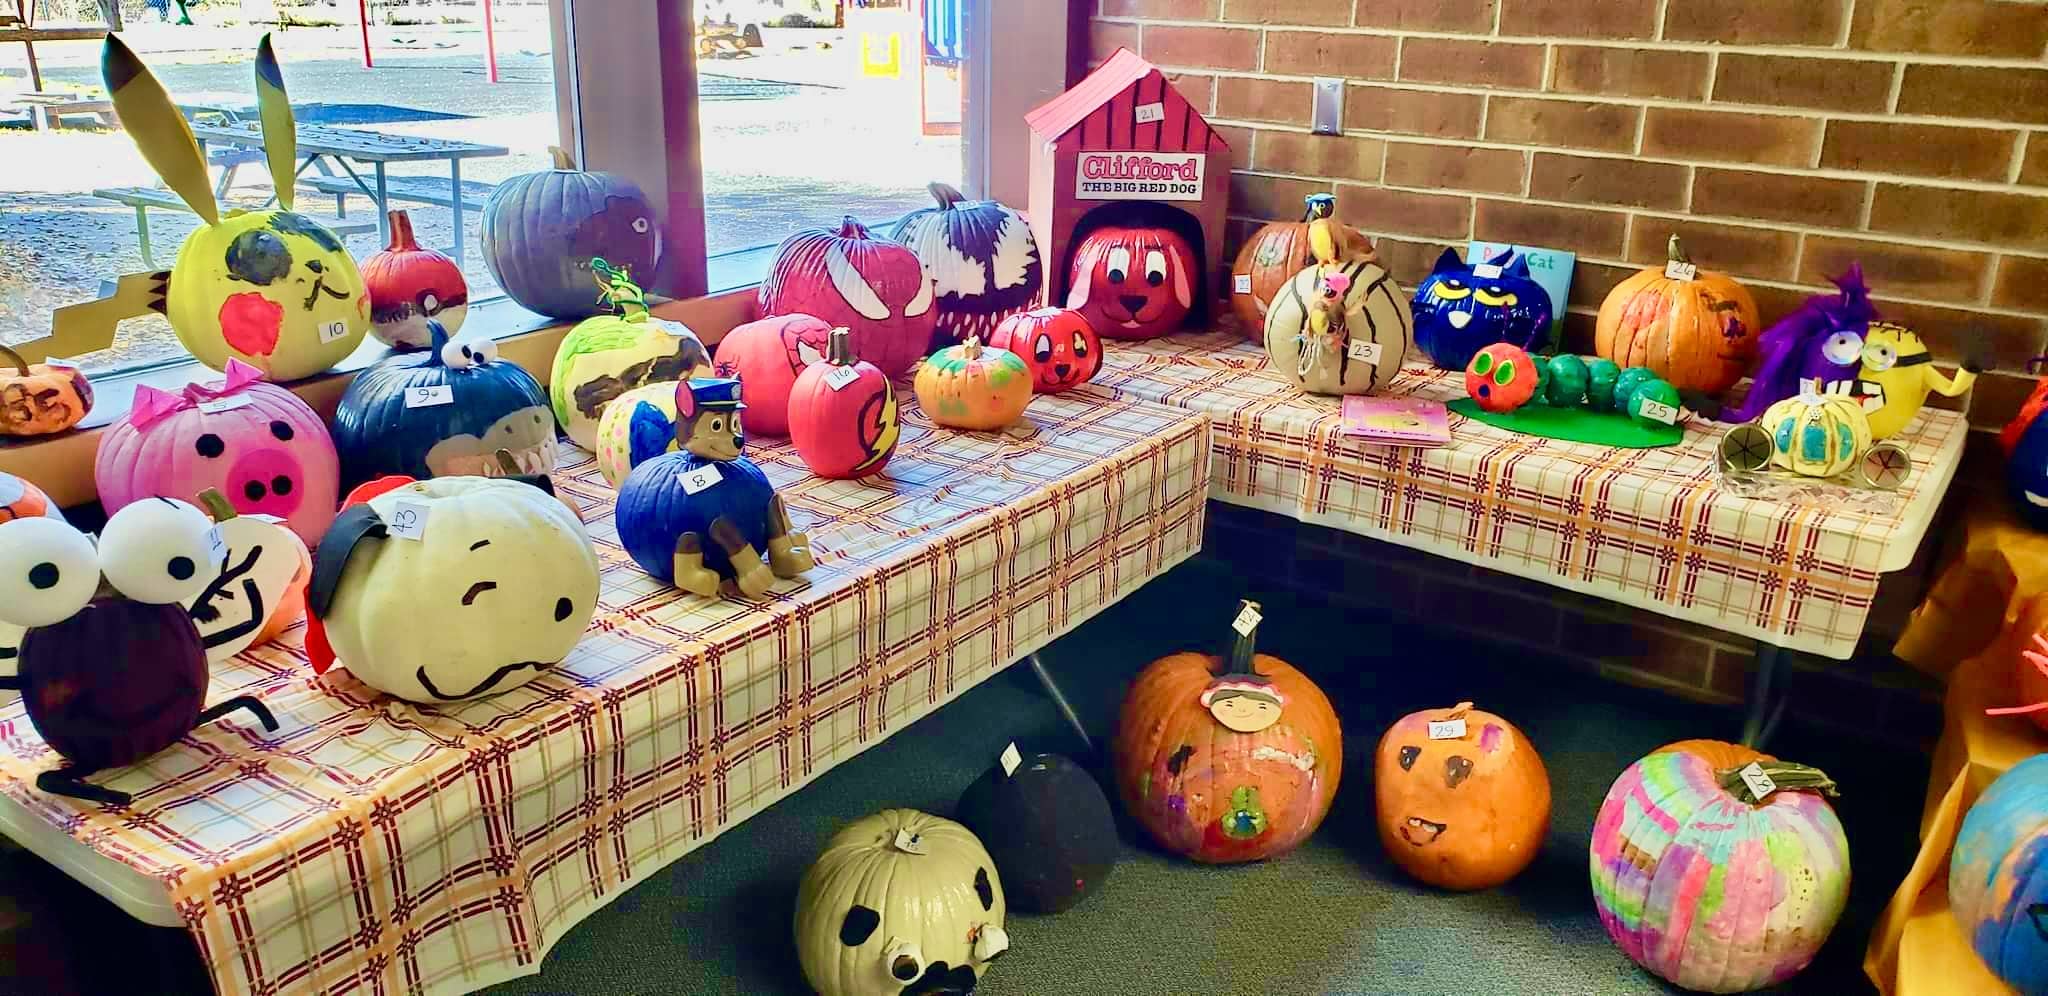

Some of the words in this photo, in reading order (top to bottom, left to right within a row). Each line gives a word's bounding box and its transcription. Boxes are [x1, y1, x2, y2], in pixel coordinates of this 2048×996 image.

[1141, 109, 1154, 120] 21
[1083, 155, 1198, 181] Clifford
[1082, 182, 1112, 192] THE
[1115, 182, 1137, 193] BIG
[1139, 183, 1167, 193] RED
[1169, 183, 1197, 194] DOG
[1527, 252, 1554, 270] Cat
[1673, 262, 1691, 276] 24
[327, 322, 343, 337] 10
[1353, 344, 1372, 358] 23
[1647, 402, 1667, 418] 25
[691, 473, 705, 488] 8
[392, 509, 416, 533] 43
[1434, 725, 1455, 737] 29
[1748, 768, 1770, 792] 28
